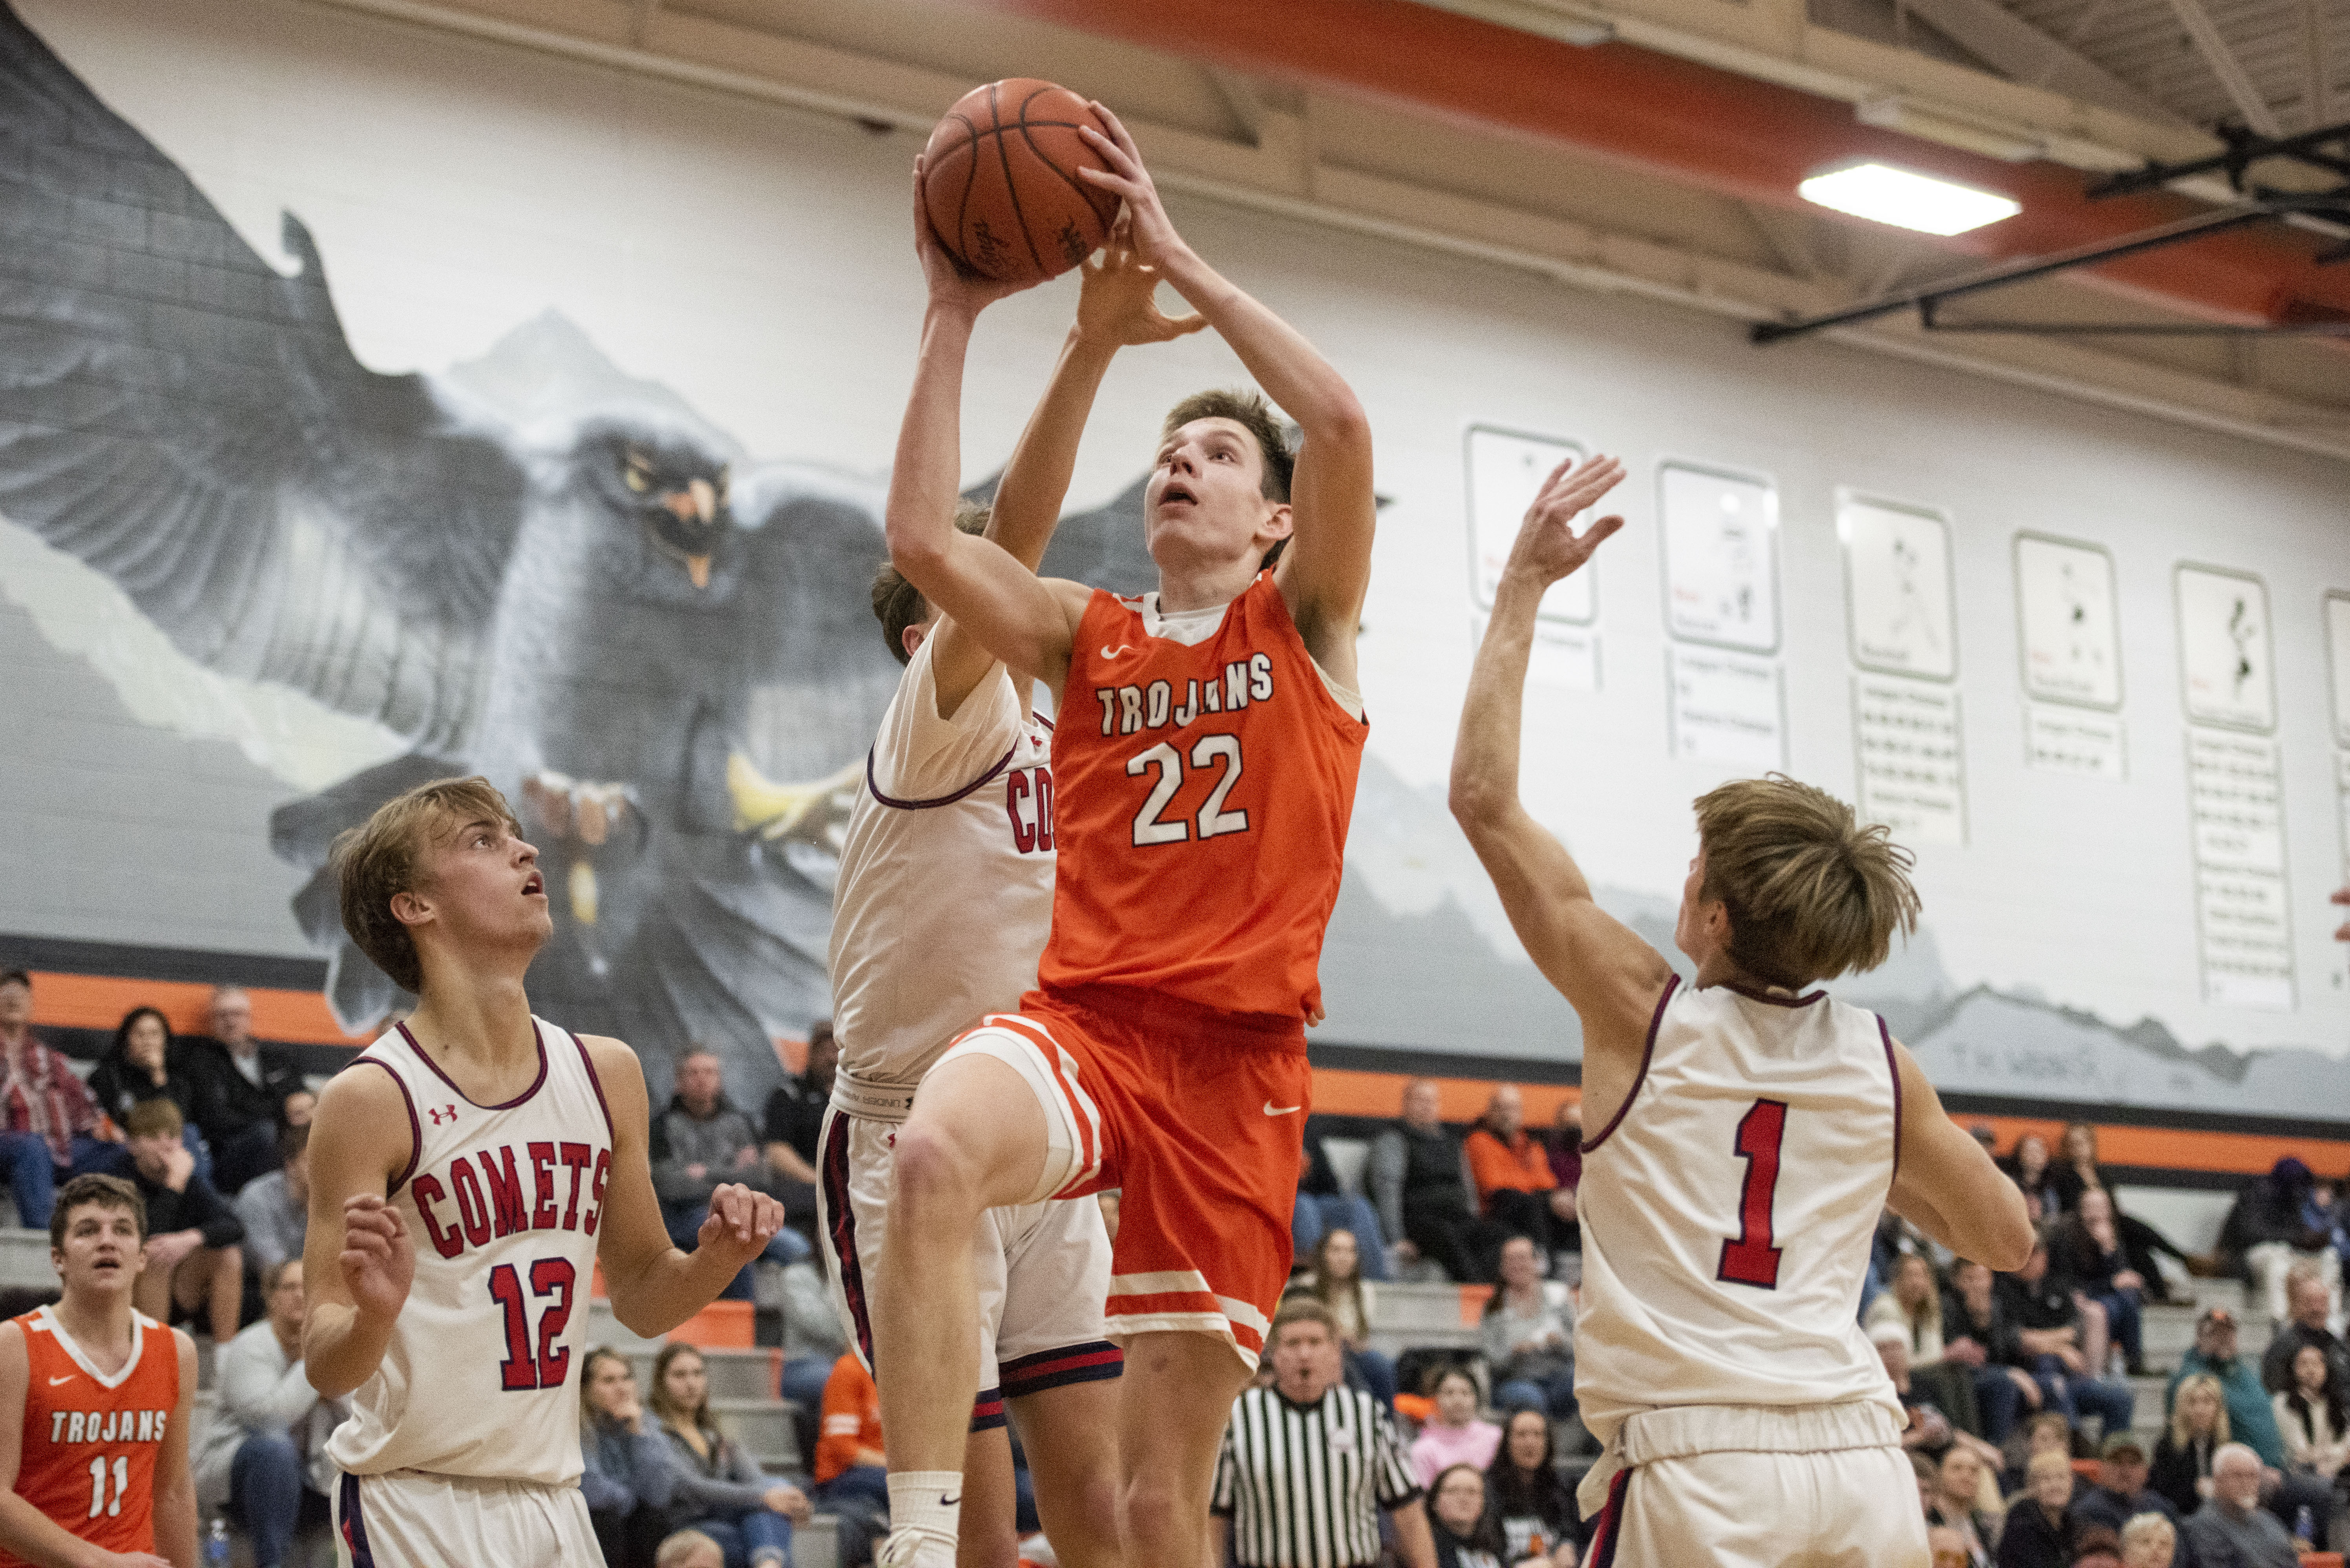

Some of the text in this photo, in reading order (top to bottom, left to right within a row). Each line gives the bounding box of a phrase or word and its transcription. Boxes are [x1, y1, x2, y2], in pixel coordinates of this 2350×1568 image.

[1097, 652, 1273, 737] TROJANS
[1007, 767, 1057, 854] CO
[1126, 733, 1250, 848] 22
[411, 1141, 611, 1259] COMETS
[1716, 1098, 1788, 1290] 1
[488, 1256, 576, 1391] 12
[50, 1409, 166, 1444] TROJANS
[89, 1455, 128, 1519] 11
